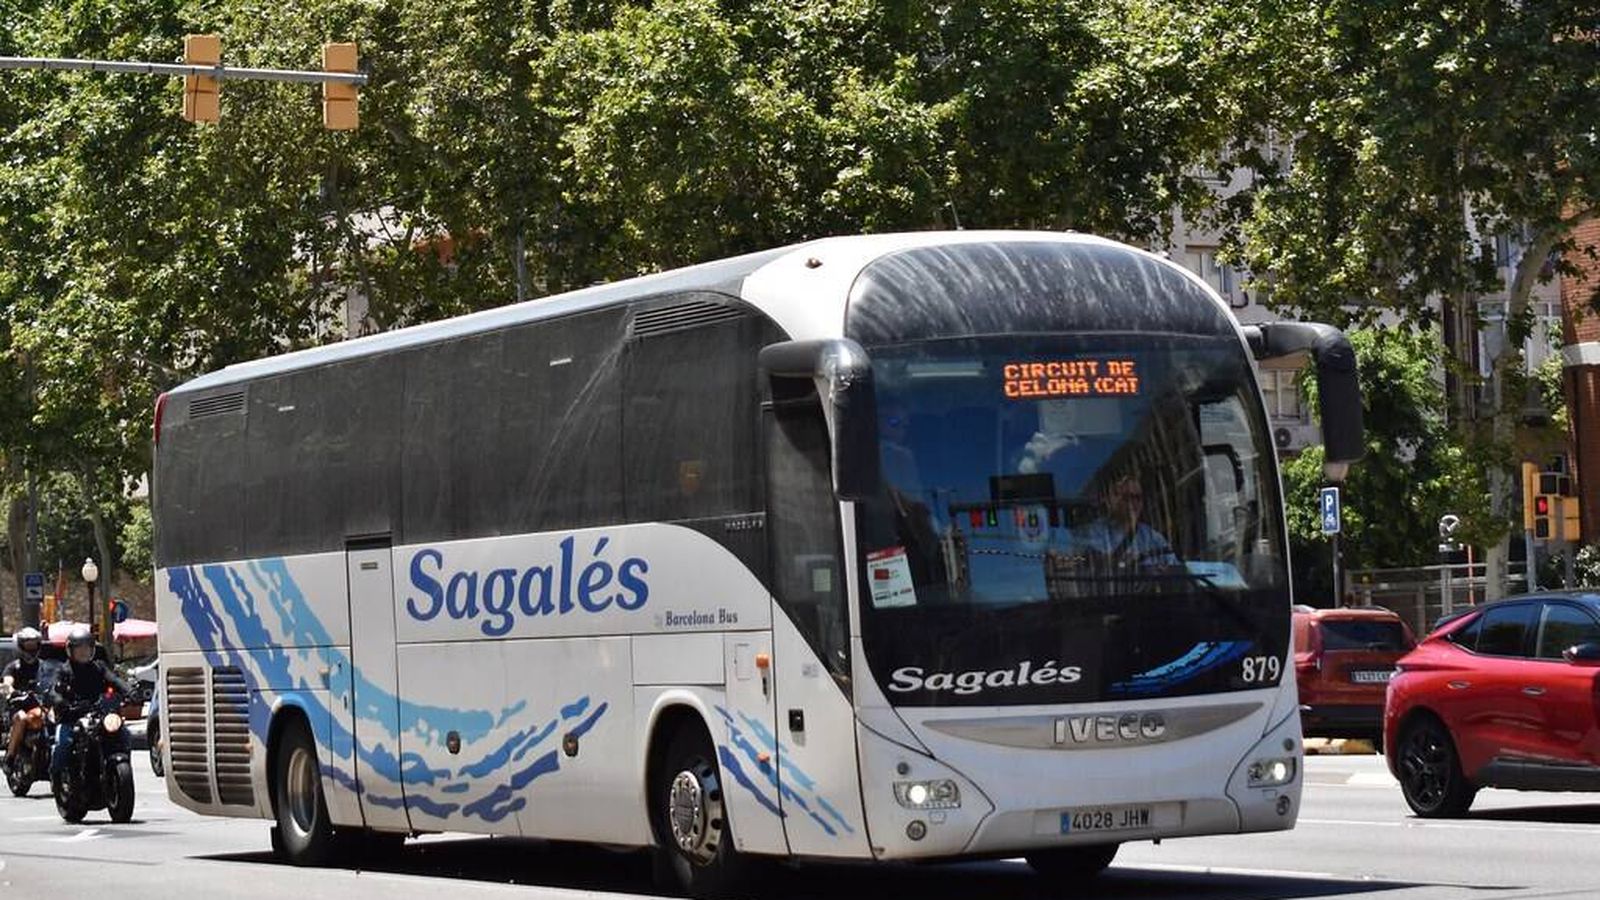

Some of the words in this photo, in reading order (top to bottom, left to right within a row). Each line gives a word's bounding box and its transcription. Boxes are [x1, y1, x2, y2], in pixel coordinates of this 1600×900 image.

[1004, 361, 1098, 379] CIRCUIT
[1107, 361, 1135, 376] DE
[1004, 379, 1088, 396] CELONA
[1094, 377, 1138, 393] (CAT
[1325, 494, 1334, 511] P
[406, 536, 649, 636] Sagalés
[666, 609, 715, 626] Barcelona
[718, 608, 738, 624] Bus
[888, 661, 1082, 694] Sagalés
[1242, 655, 1280, 681] 879
[1054, 714, 1165, 744] IVECO
[1072, 811, 1113, 830] 4028
[1119, 808, 1149, 827] JHW
